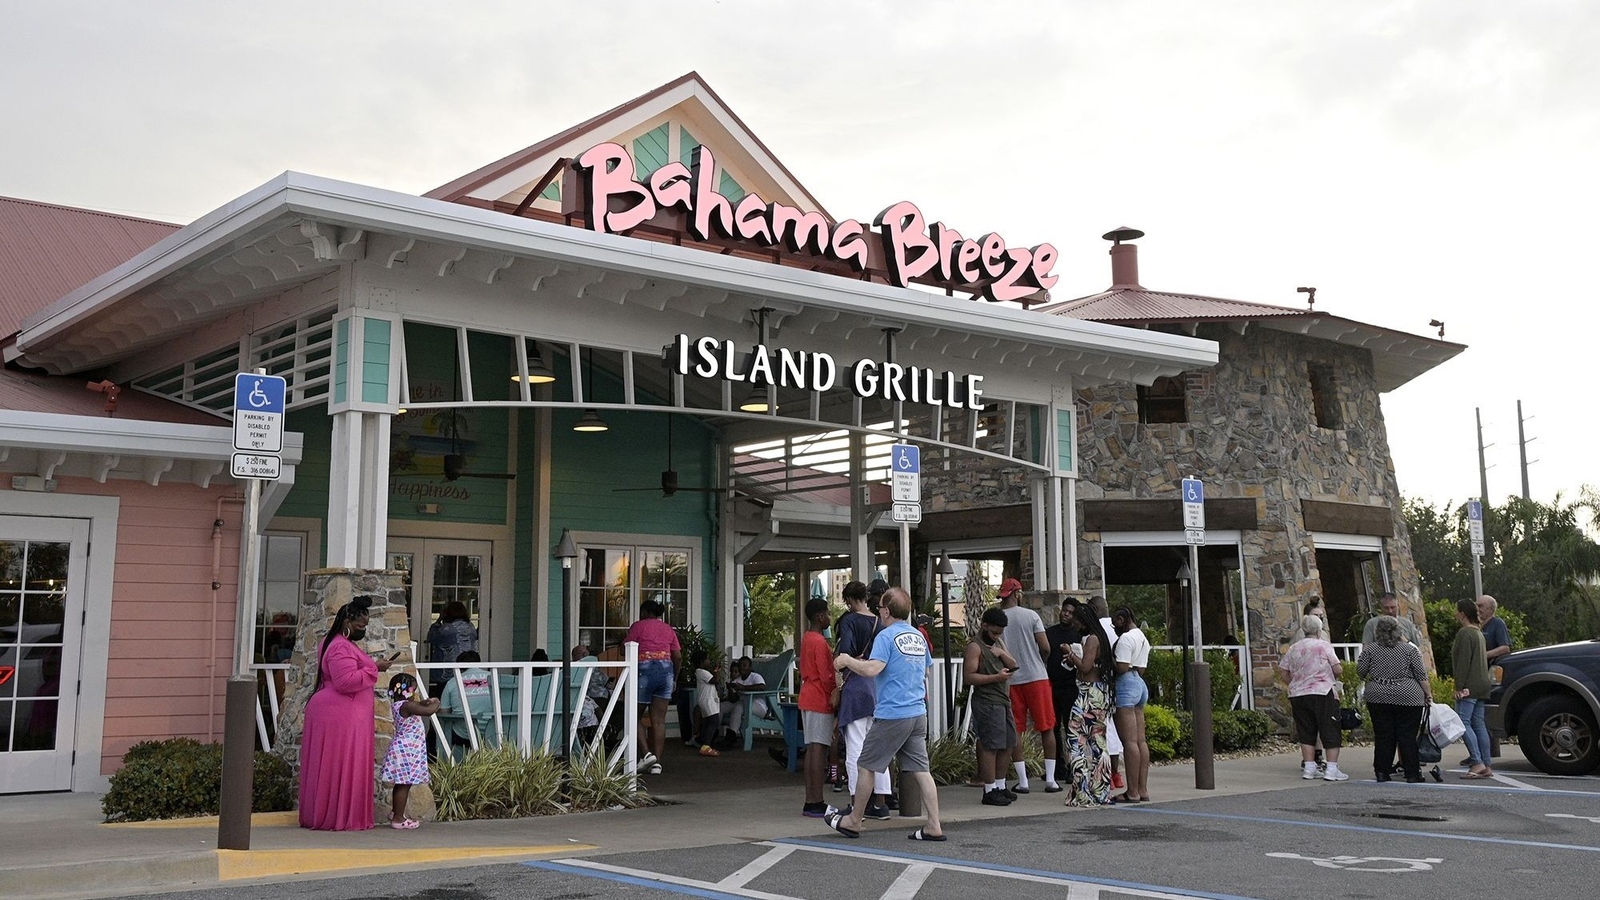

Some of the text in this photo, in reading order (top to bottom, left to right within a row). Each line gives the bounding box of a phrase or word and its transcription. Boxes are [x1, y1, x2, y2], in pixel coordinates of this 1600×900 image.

[579, 142, 868, 270] Bahama
[878, 201, 1059, 300] Breeze
[679, 333, 985, 410] ISLAND GRILLE
[898, 635, 912, 646] RON
